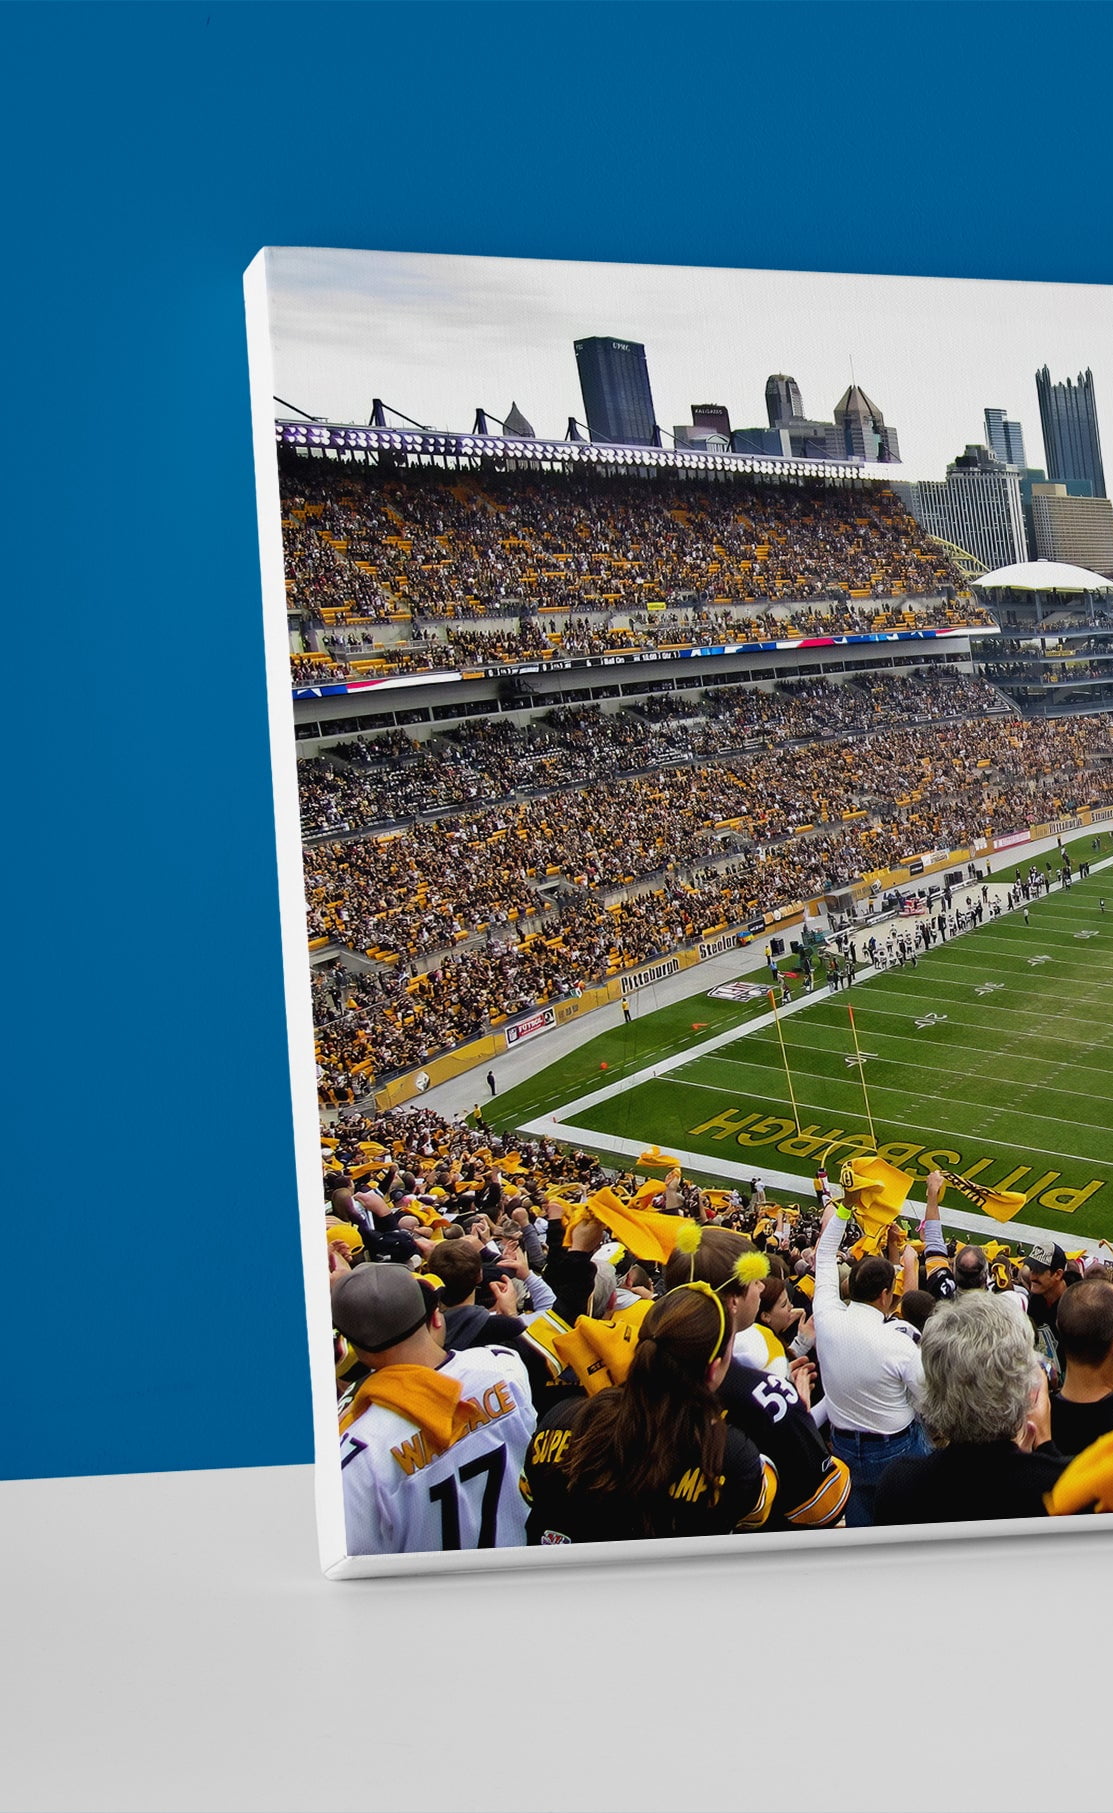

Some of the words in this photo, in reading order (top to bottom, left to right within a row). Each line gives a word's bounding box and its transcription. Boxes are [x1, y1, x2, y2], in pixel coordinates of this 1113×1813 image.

[700, 934, 738, 959] Steeler
[621, 959, 679, 994] Pittsburgh
[752, 1374, 799, 1423] 53
[429, 1443, 507, 1551] 17
